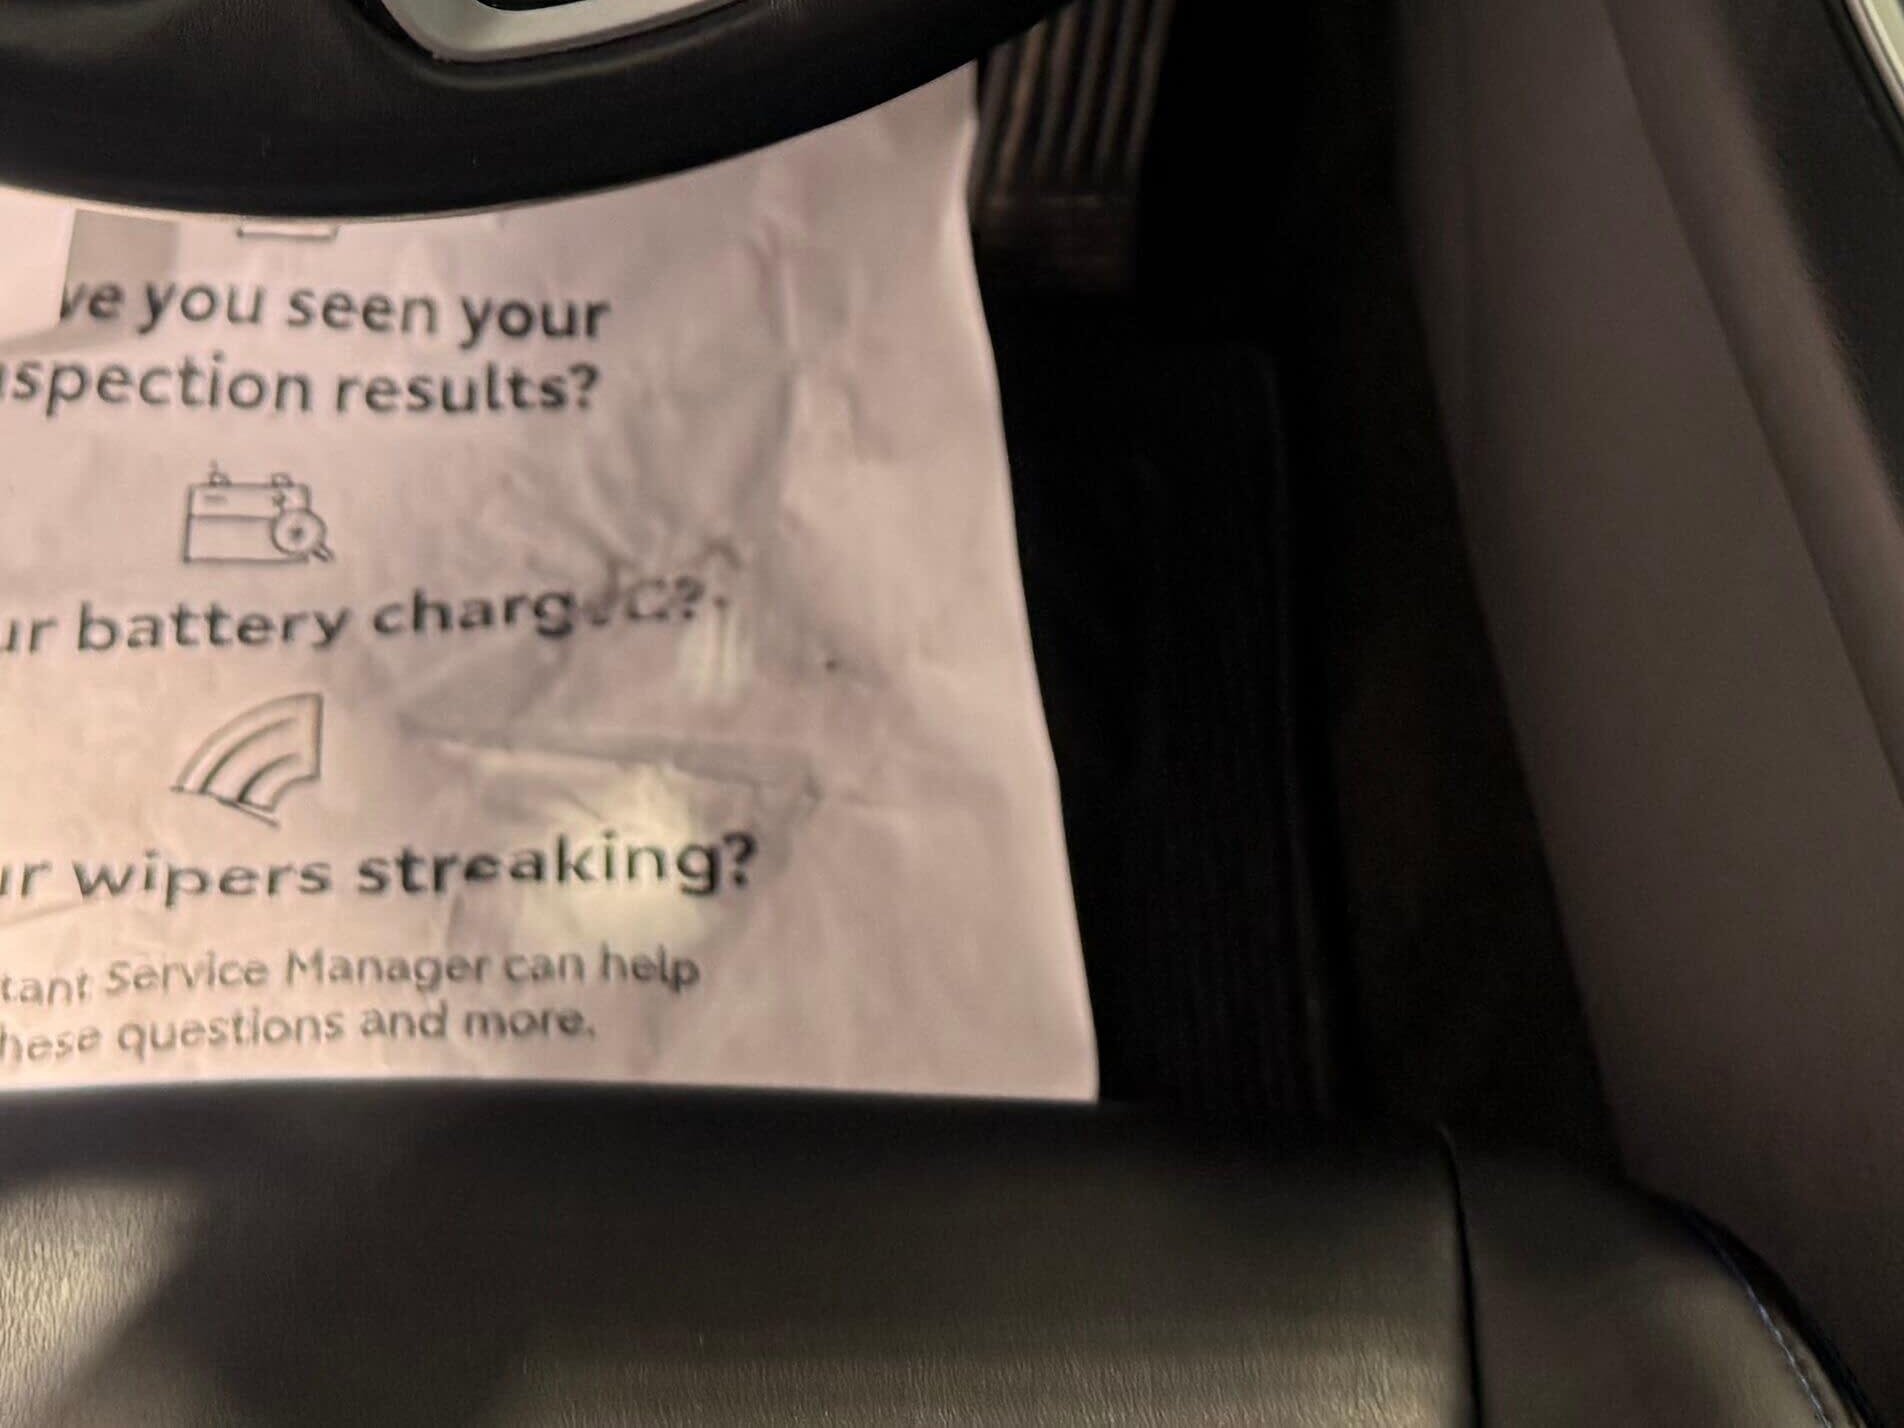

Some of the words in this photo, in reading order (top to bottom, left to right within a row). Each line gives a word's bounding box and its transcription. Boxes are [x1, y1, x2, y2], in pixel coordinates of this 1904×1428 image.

[58, 281, 124, 320] ve
[138, 282, 265, 334] you
[287, 289, 439, 333] seen
[460, 297, 612, 350] your
[335, 361, 601, 415] results?
[77, 600, 353, 655] battery
[371, 575, 704, 642] charg?
[71, 848, 334, 910] wipers
[354, 831, 759, 897] streaking?
[104, 951, 269, 996] Service
[285, 945, 490, 994] Manager
[502, 947, 587, 986] can
[599, 942, 701, 993] help
[116, 1004, 345, 1057] questions
[359, 1000, 448, 1041] and
[464, 1003, 597, 1041] more.
